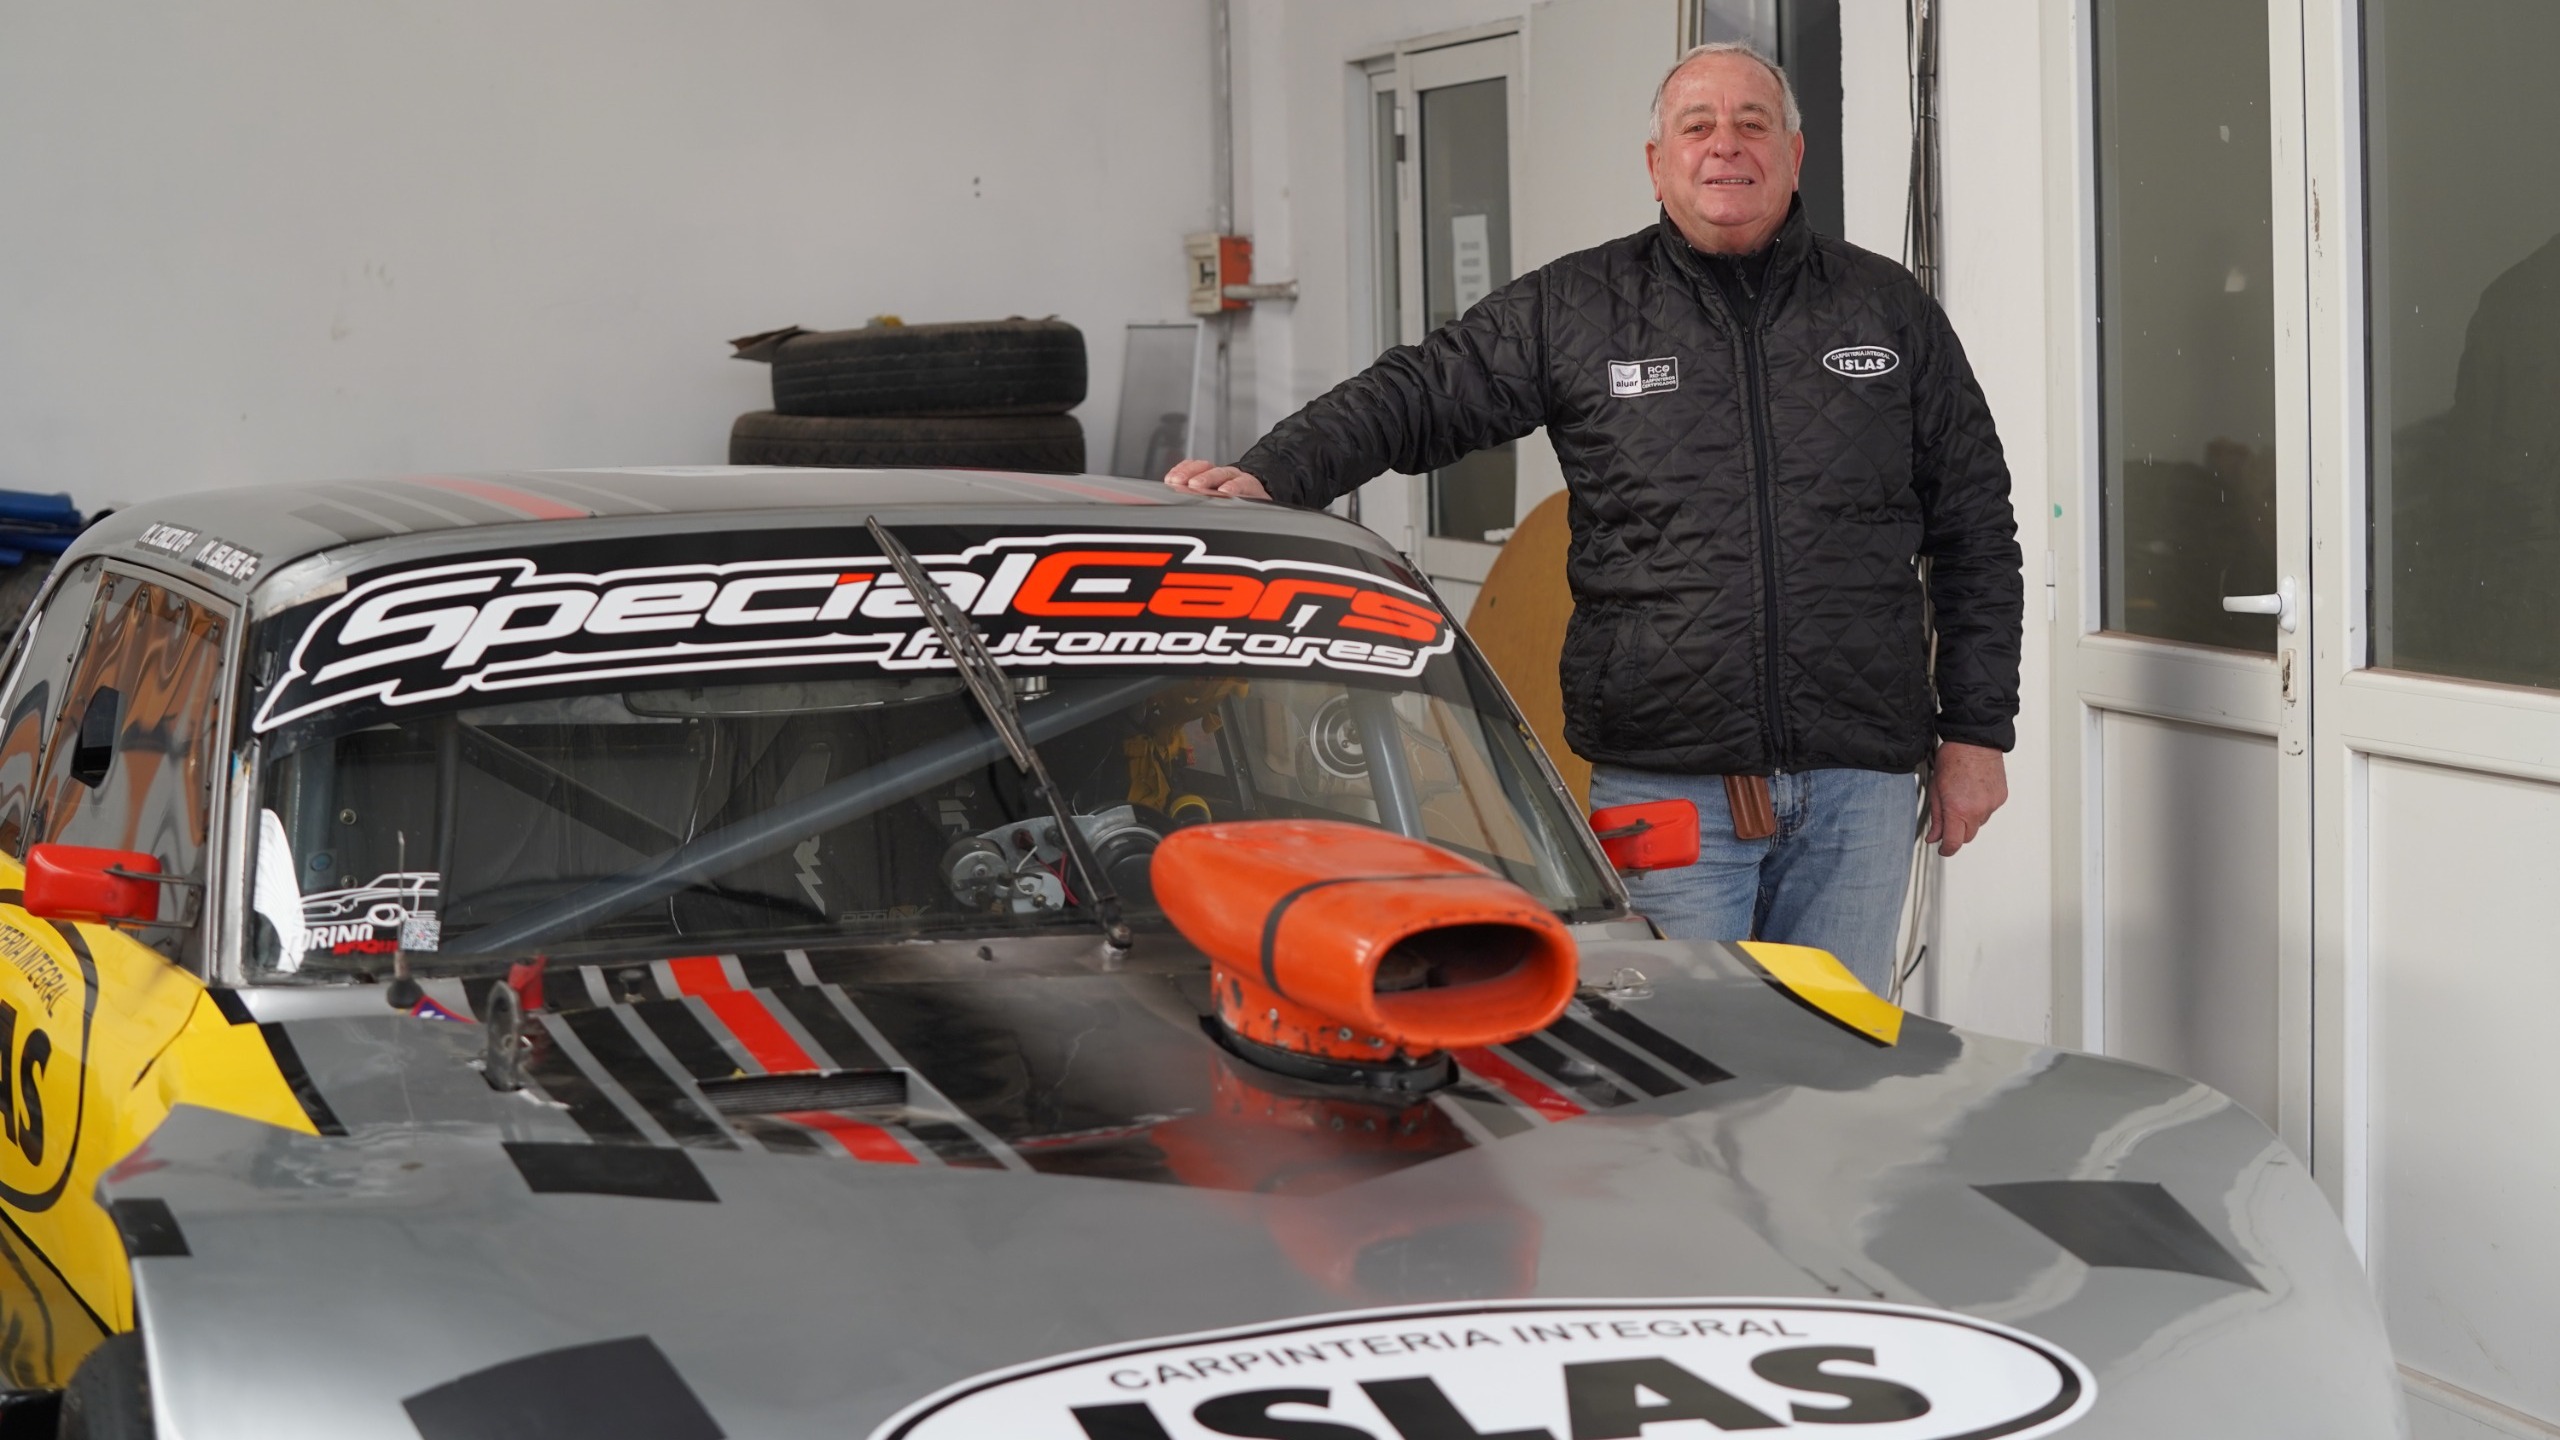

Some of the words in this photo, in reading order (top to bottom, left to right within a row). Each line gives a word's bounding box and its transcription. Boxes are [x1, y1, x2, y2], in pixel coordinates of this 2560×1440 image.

[1831, 351, 1864, 360] CARPINTERIA
[1865, 351, 1890, 360] INTEGRAL
[1839, 359, 1885, 370] ISLAS
[901, 625, 1414, 667] Automotores
[14, 944, 69, 1019] INTEGRAL
[1108, 1327, 1501, 1390] CARPINTERIA
[1511, 1318, 1809, 1344] INTEGRAL
